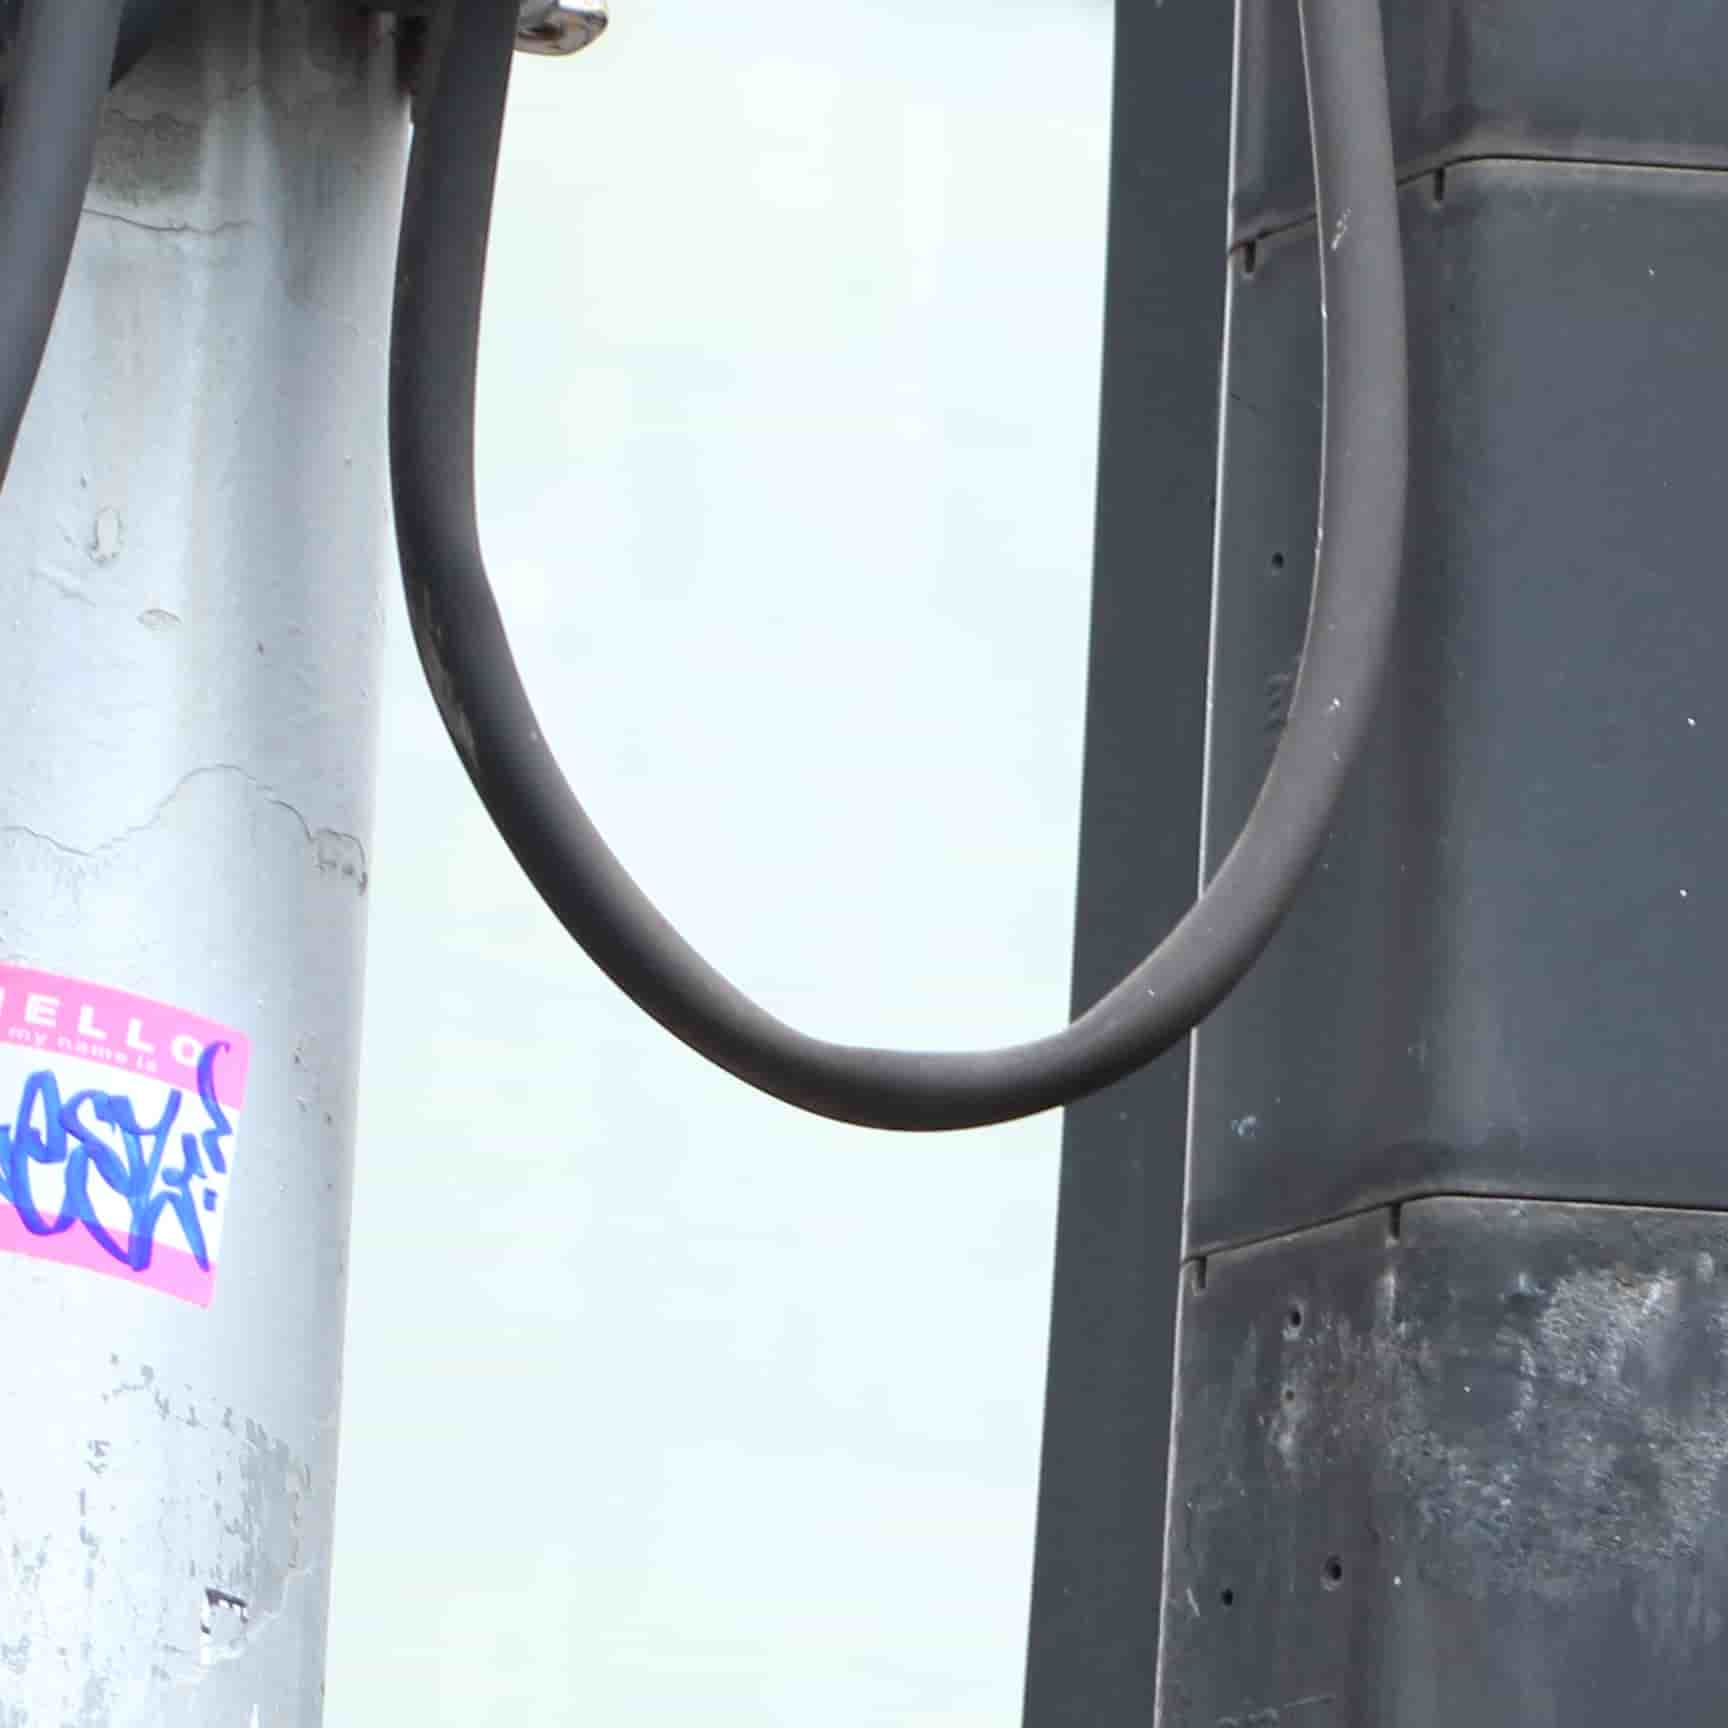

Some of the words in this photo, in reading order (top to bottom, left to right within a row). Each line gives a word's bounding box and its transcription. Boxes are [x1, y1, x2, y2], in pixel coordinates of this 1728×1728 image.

[0, 985, 204, 1068] ELLO
[7, 1025, 48, 1047] my
[56, 1035, 129, 1065] name
[136, 1054, 159, 1073] is
